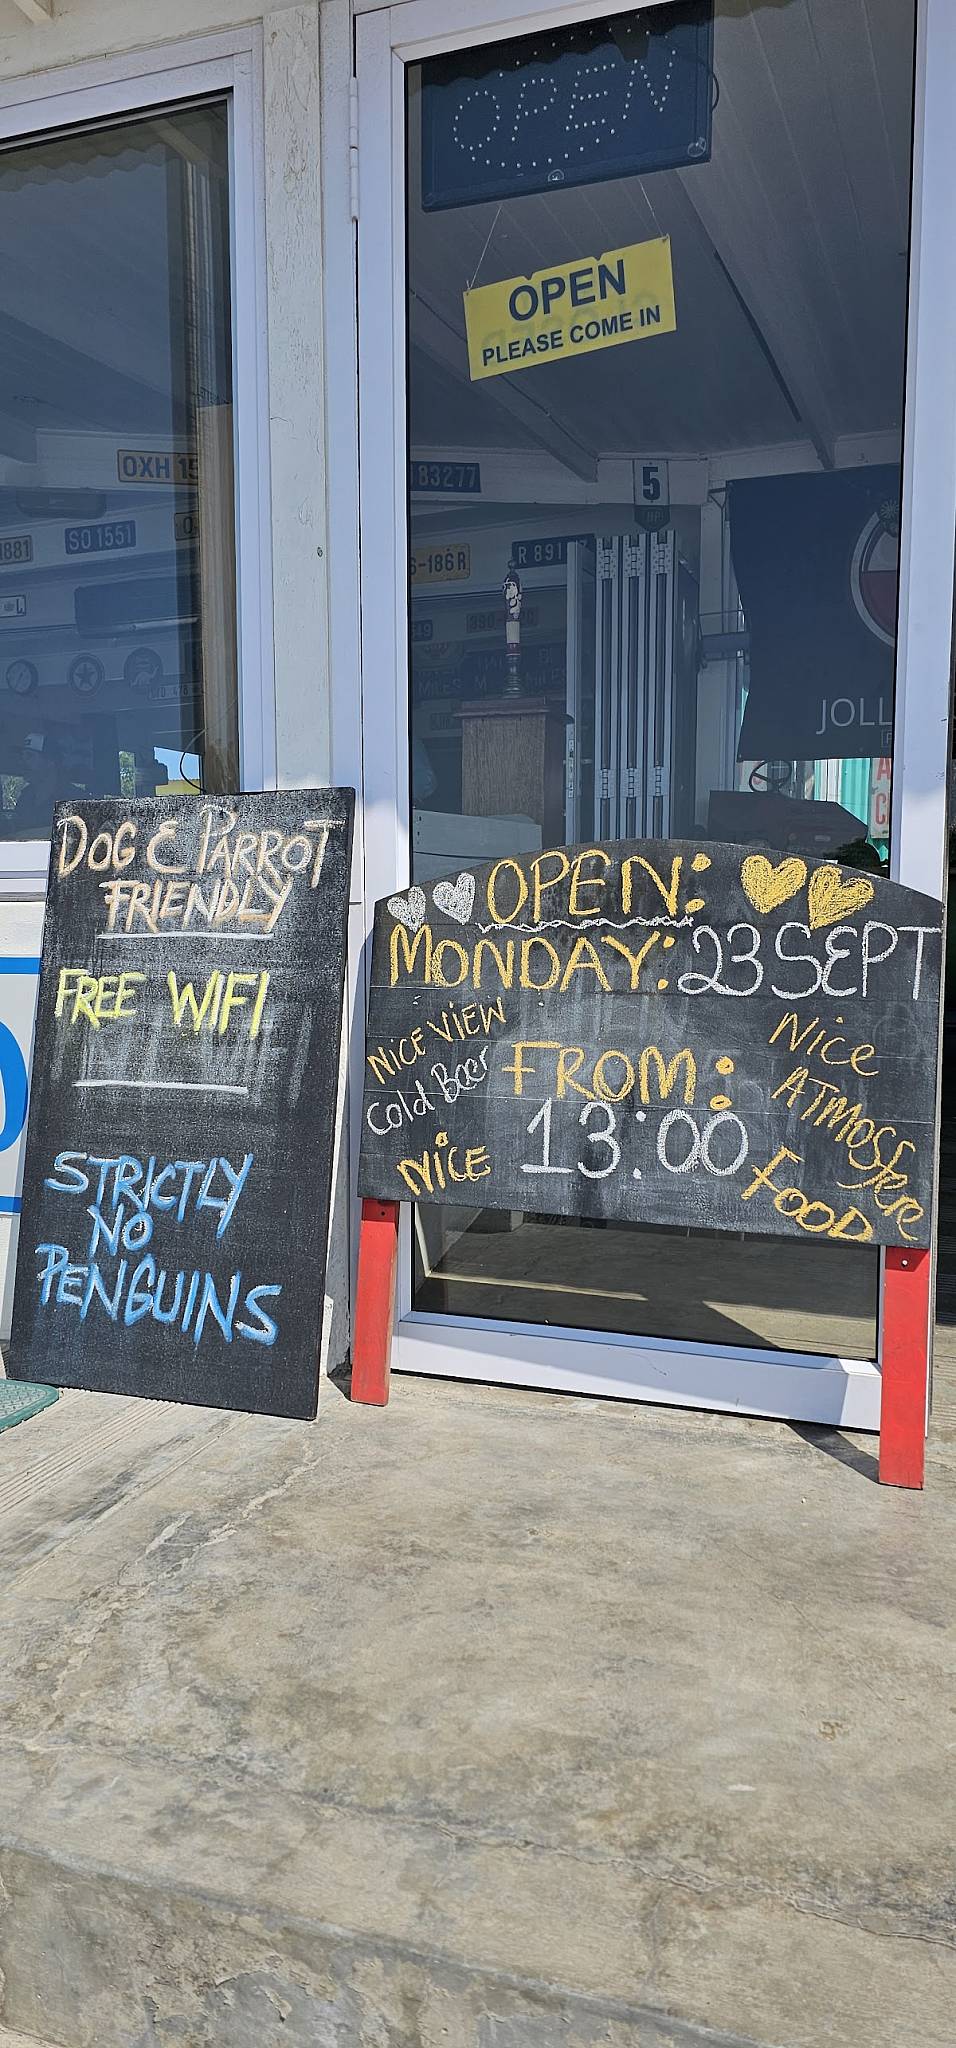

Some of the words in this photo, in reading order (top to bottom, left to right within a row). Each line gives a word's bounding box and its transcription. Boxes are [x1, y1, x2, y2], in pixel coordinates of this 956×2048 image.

[453, 49, 676, 152] OPEN
[508, 258, 627, 322] OPEN
[482, 329, 564, 367] PLEASE
[569, 310, 633, 344] COME
[639, 304, 661, 328] IN
[122, 455, 170, 479] OXH
[409, 464, 477, 488] 83277
[642, 466, 661, 501] 5
[518, 546, 527, 565] R
[57, 815, 137, 879] DOG
[199, 803, 346, 888] PARROT
[100, 876, 294, 934] FRIENDLY
[487, 849, 712, 924] OPEN:
[389, 923, 676, 993] MONDAY:
[677, 923, 764, 997] 23
[771, 920, 942, 1000] SEPT
[54, 968, 147, 1031] FREE
[167, 969, 271, 1040] WIFI
[502, 1040, 735, 1111] FROM:
[520, 1096, 749, 1179] 13:00
[44, 1151, 254, 1240] STRICTLY
[740, 1144, 875, 1243] FOOD
[86, 1203, 154, 1259] NO
[35, 1243, 283, 1347] PENGUINS
